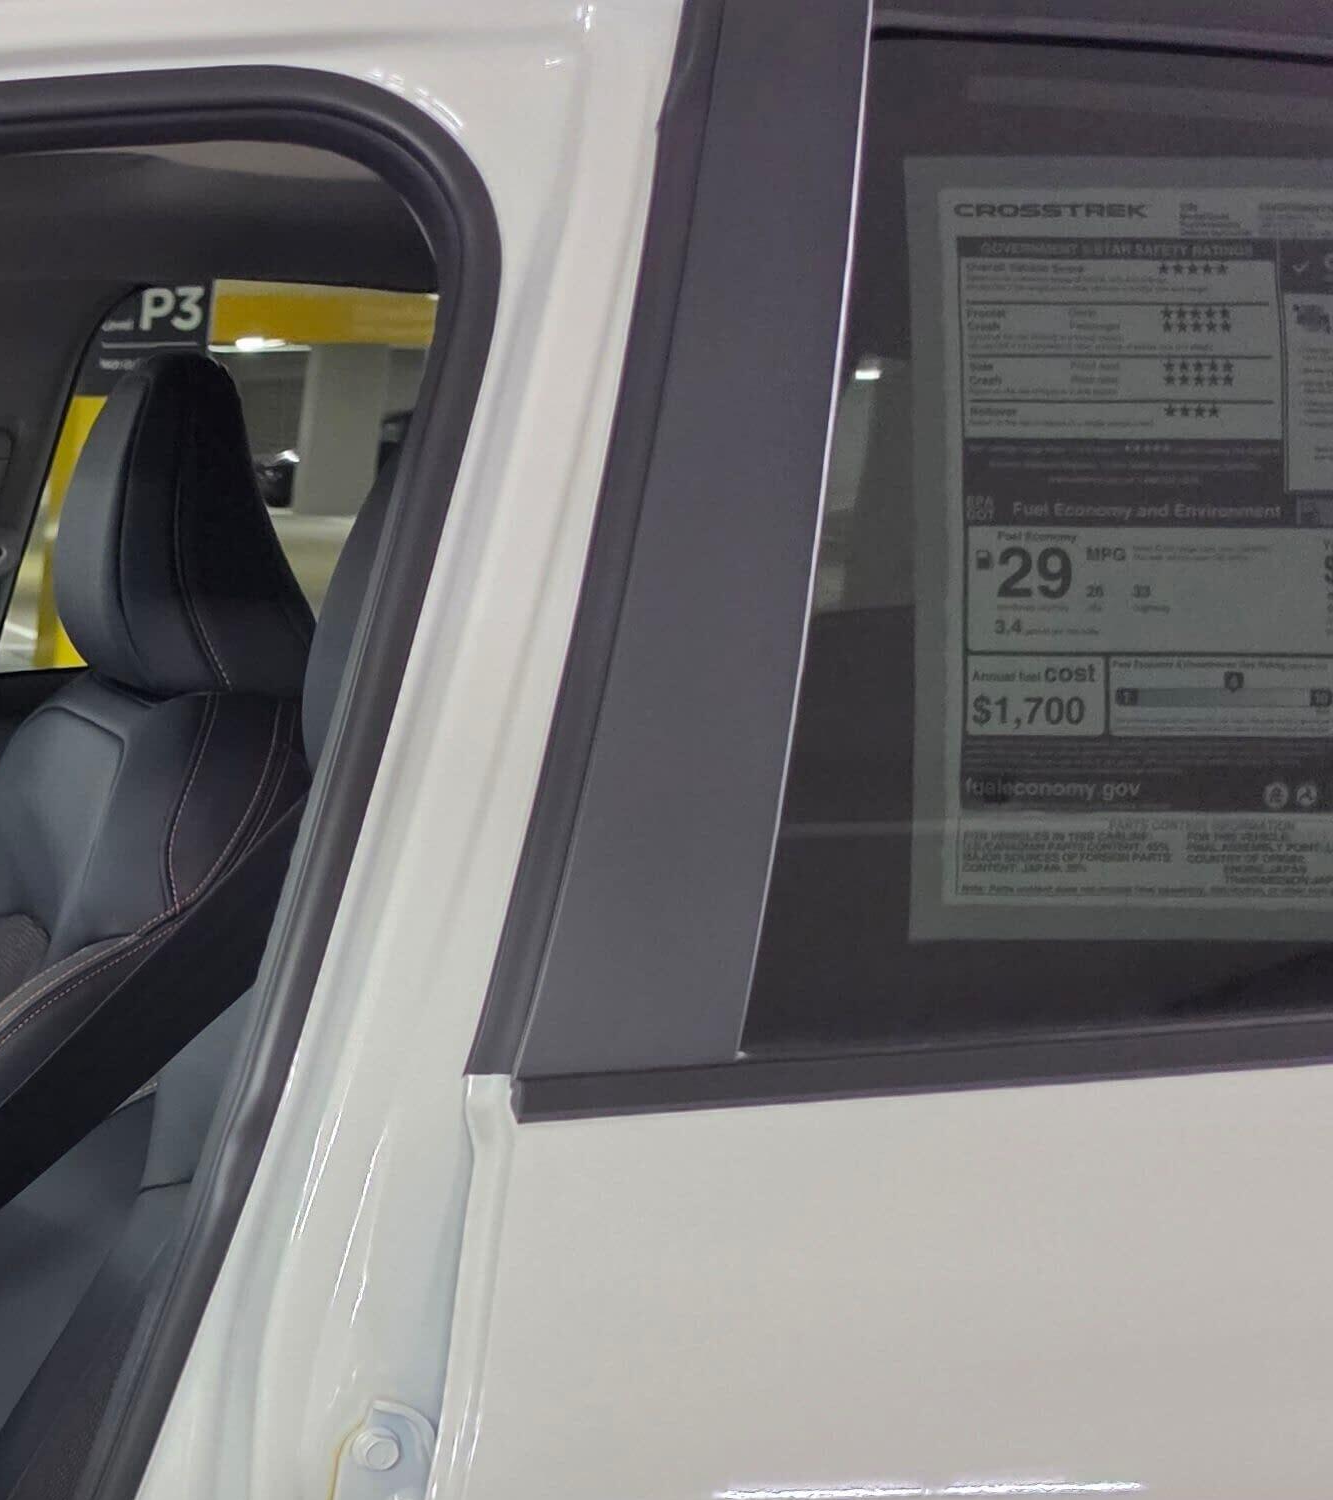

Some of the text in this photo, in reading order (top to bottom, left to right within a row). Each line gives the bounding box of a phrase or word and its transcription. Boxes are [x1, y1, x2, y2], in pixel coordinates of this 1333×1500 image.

[954, 203, 1148, 218] CROSSTREK
[1134, 244, 1188, 257] SAFETY
[139, 286, 204, 331] P3
[1013, 502, 1282, 520] Fuel Economy and Environment
[1086, 547, 1126, 561] MPG
[997, 546, 1072, 599] 29
[972, 670, 1017, 682] Annual
[1044, 664, 1096, 682] cost
[972, 694, 1085, 730] $1,700
